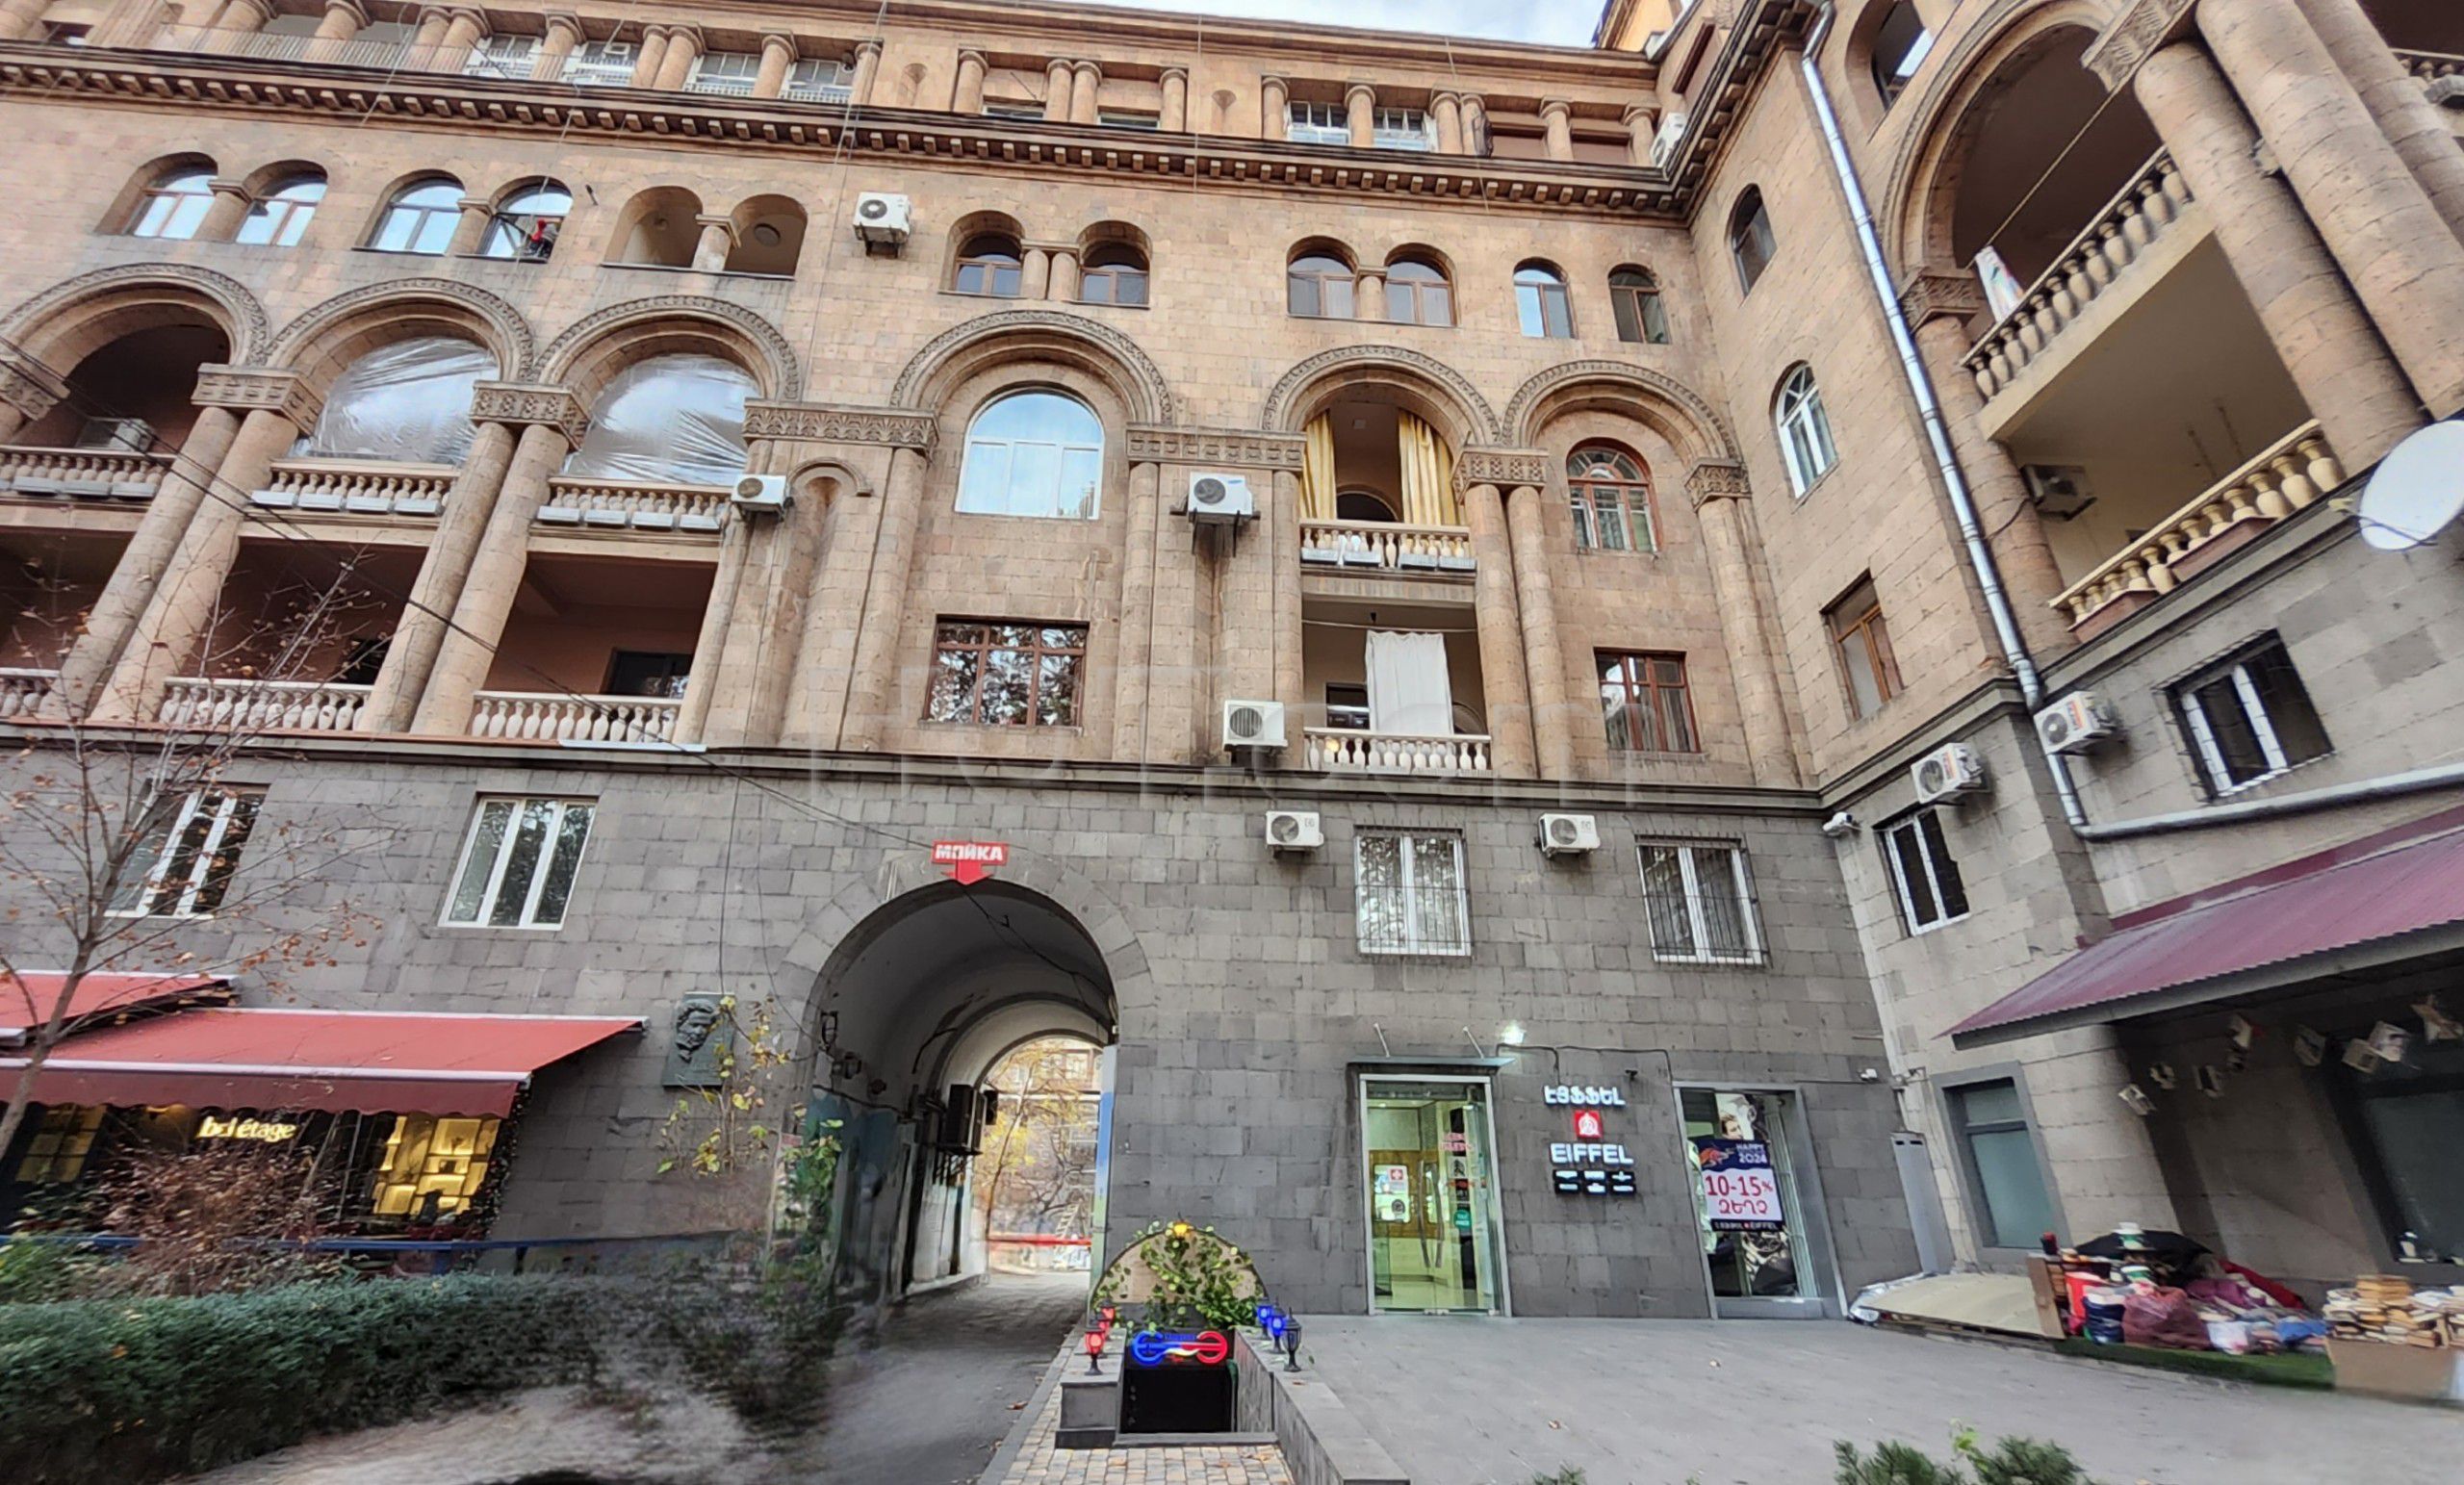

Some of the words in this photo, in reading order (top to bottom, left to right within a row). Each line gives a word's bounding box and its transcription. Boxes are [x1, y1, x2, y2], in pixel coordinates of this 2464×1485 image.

[935, 843, 1003, 860] МОЙКА
[1551, 1143, 1634, 1164] EIFFEL
[1738, 1153, 1767, 1164] 2024
[1705, 1175, 1773, 1196] 10-15%
